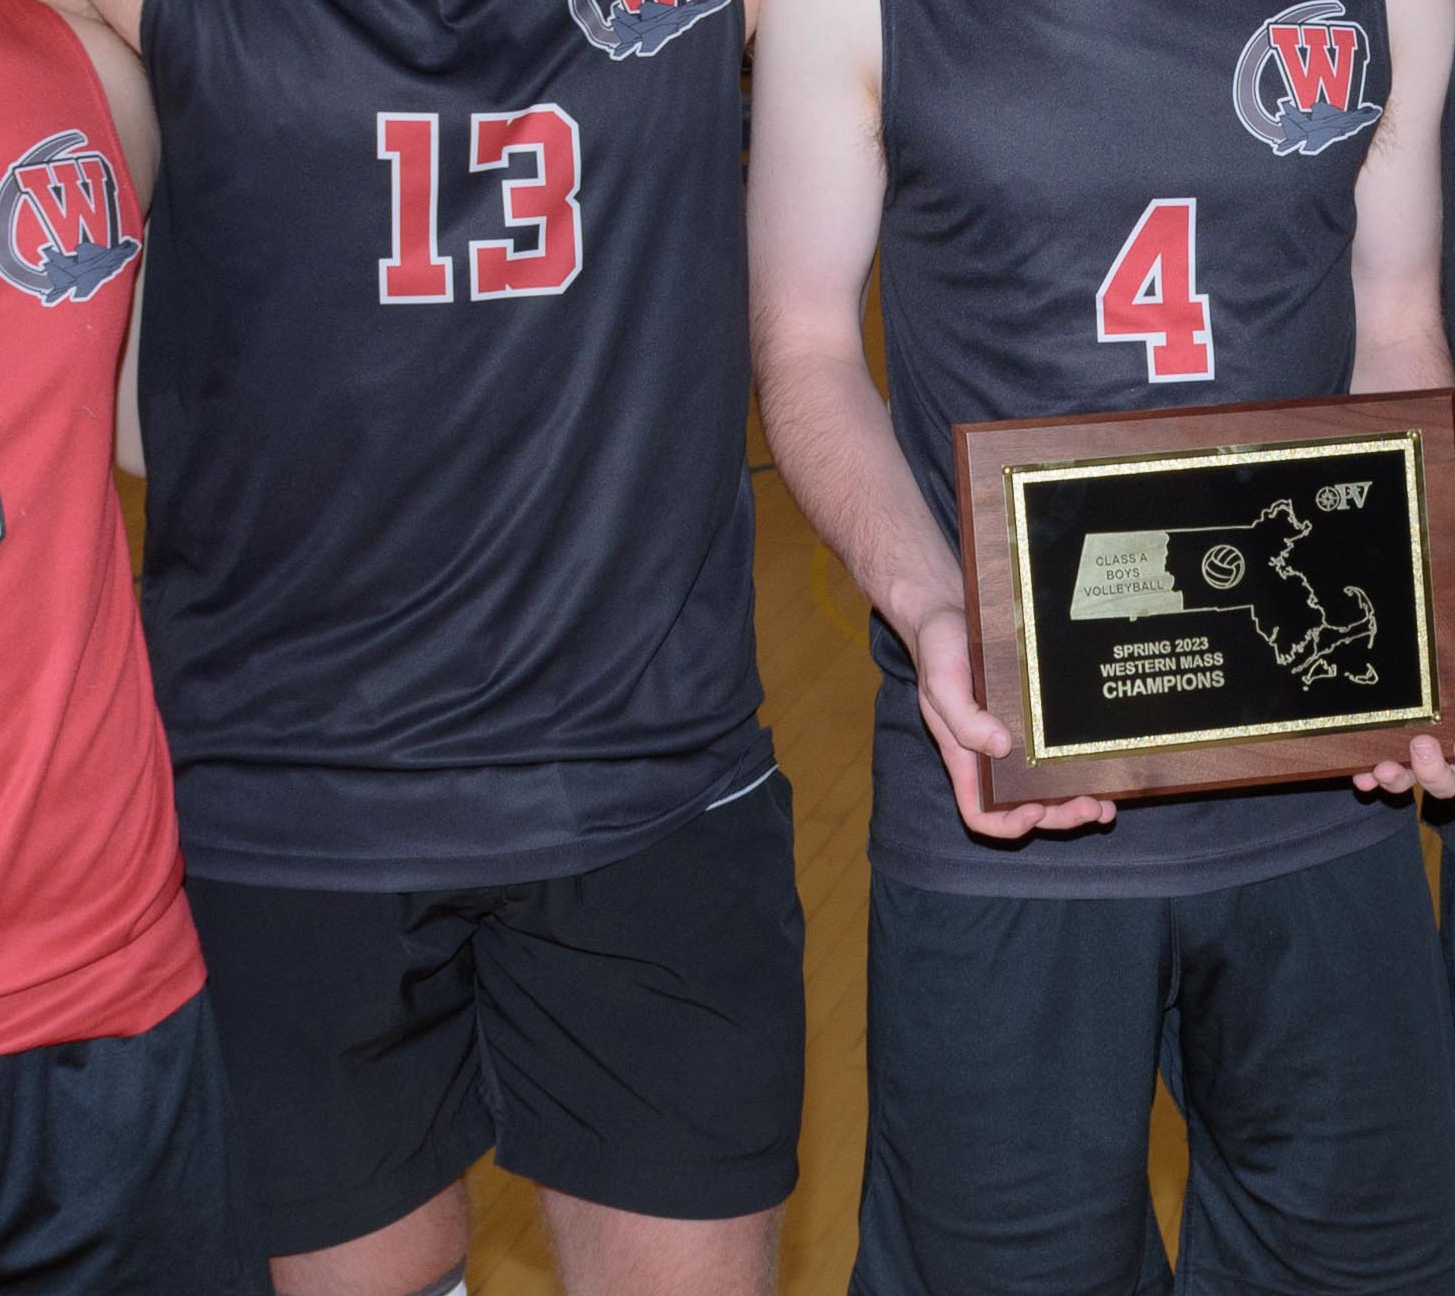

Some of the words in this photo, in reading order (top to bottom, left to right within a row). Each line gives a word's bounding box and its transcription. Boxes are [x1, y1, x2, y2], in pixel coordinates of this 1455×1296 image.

[377, 103, 583, 304] 13
[1096, 197, 1215, 383] 4
[1096, 553, 1137, 566] CLASS
[1139, 552, 1148, 562] A
[1106, 567, 1140, 579] BOYS
[1083, 579, 1164, 597] VOLLEYBALL
[1113, 640, 1171, 659] SPRING
[1175, 636, 1209, 652] 2023
[1100, 655, 1177, 678] WESTERN
[1180, 652, 1224, 669] MASS
[1102, 670, 1225, 699] CHAMPIONS
